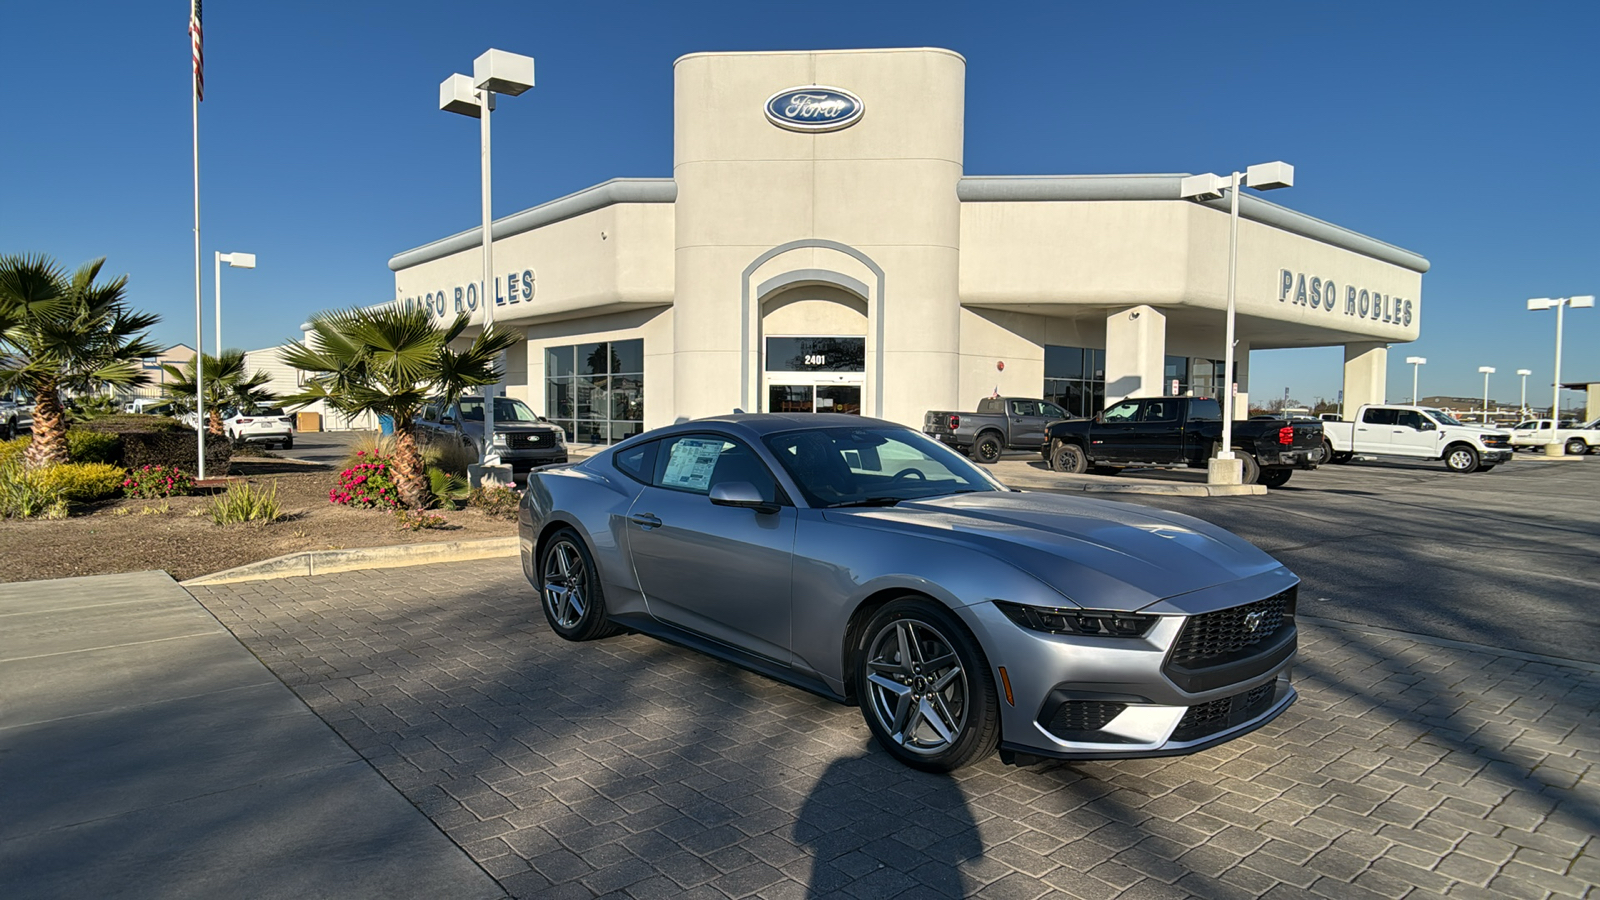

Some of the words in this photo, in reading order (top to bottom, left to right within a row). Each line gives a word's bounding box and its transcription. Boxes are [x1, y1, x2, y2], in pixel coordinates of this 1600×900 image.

[785, 93, 844, 118] Ford
[454, 269, 535, 314] ROLES
[1278, 268, 1336, 312] PASO
[1344, 285, 1412, 327] ROBLES
[804, 354, 826, 365] 2401
